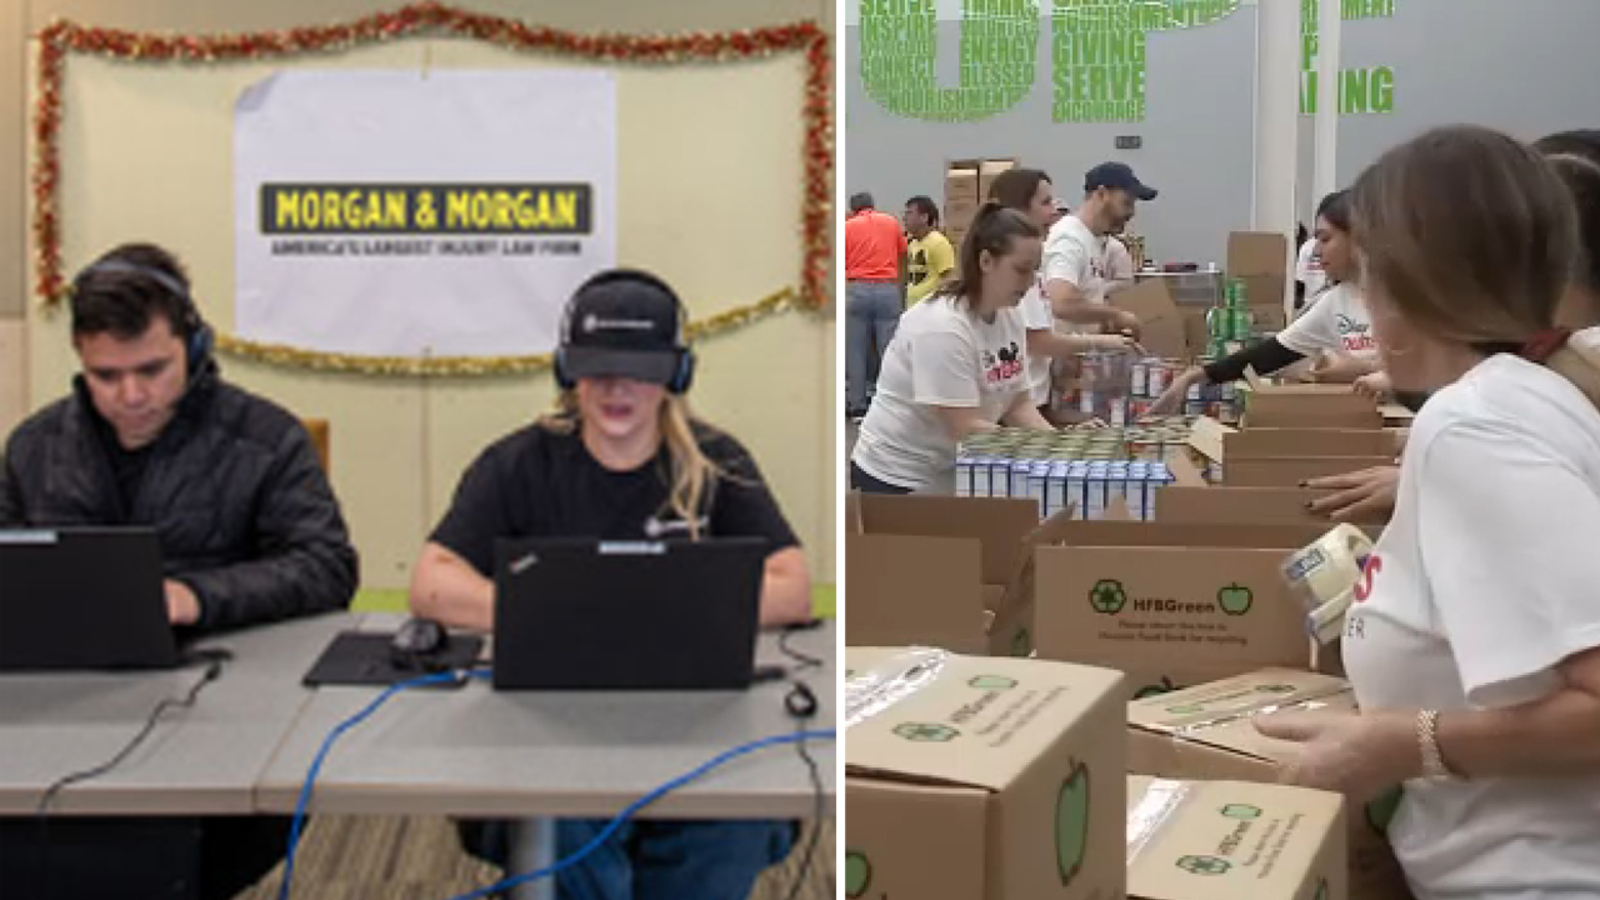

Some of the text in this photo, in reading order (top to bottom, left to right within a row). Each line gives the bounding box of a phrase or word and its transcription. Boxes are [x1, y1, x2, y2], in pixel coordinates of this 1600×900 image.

[861, 15, 936, 41] INSPIRE
[962, 35, 1037, 63] ENERGY
[1052, 31, 1145, 64] GIVING
[962, 63, 1036, 87] BLESSED
[1052, 65, 1145, 101] SERVE
[1052, 101, 1145, 123] ENCOURAGE
[275, 190, 577, 228] MORGAN & MORGAN
[271, 241, 360, 255] AMERICA'S
[364, 241, 432, 255] LARGEST
[1134, 598, 1215, 612] HFBGreen
